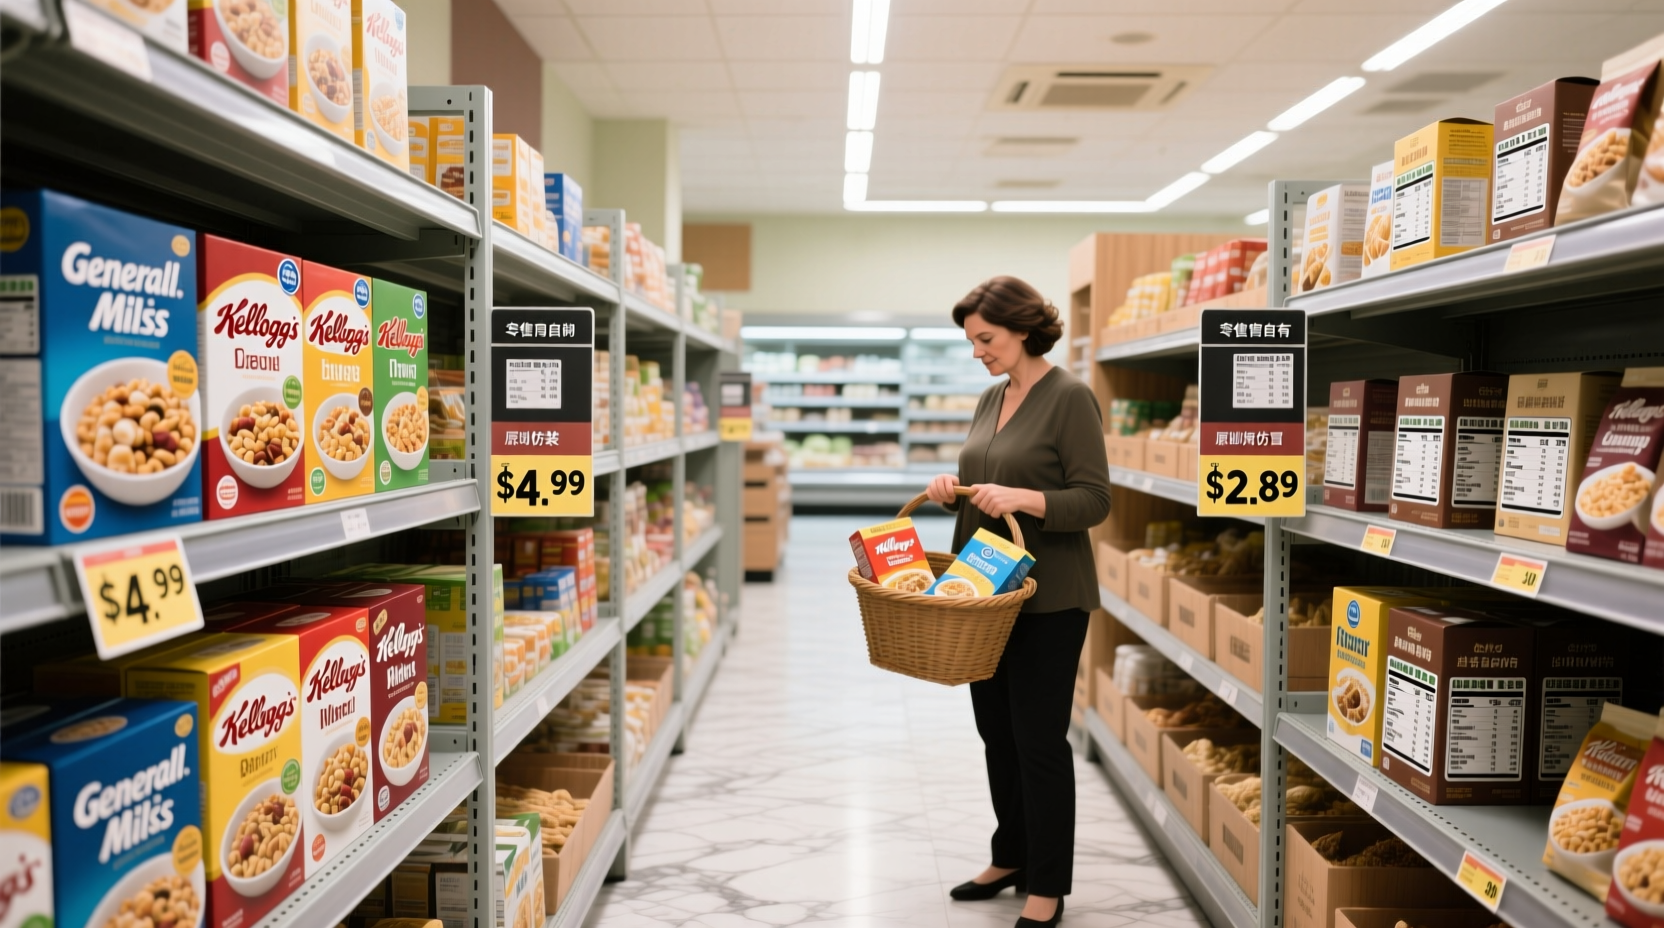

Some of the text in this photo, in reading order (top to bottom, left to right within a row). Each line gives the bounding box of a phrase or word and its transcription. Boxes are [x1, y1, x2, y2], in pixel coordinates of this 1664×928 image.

[497, 465, 585, 506] $4.99
[1206, 465, 1299, 505] $2.89
[99, 564, 184, 625] $4.99
